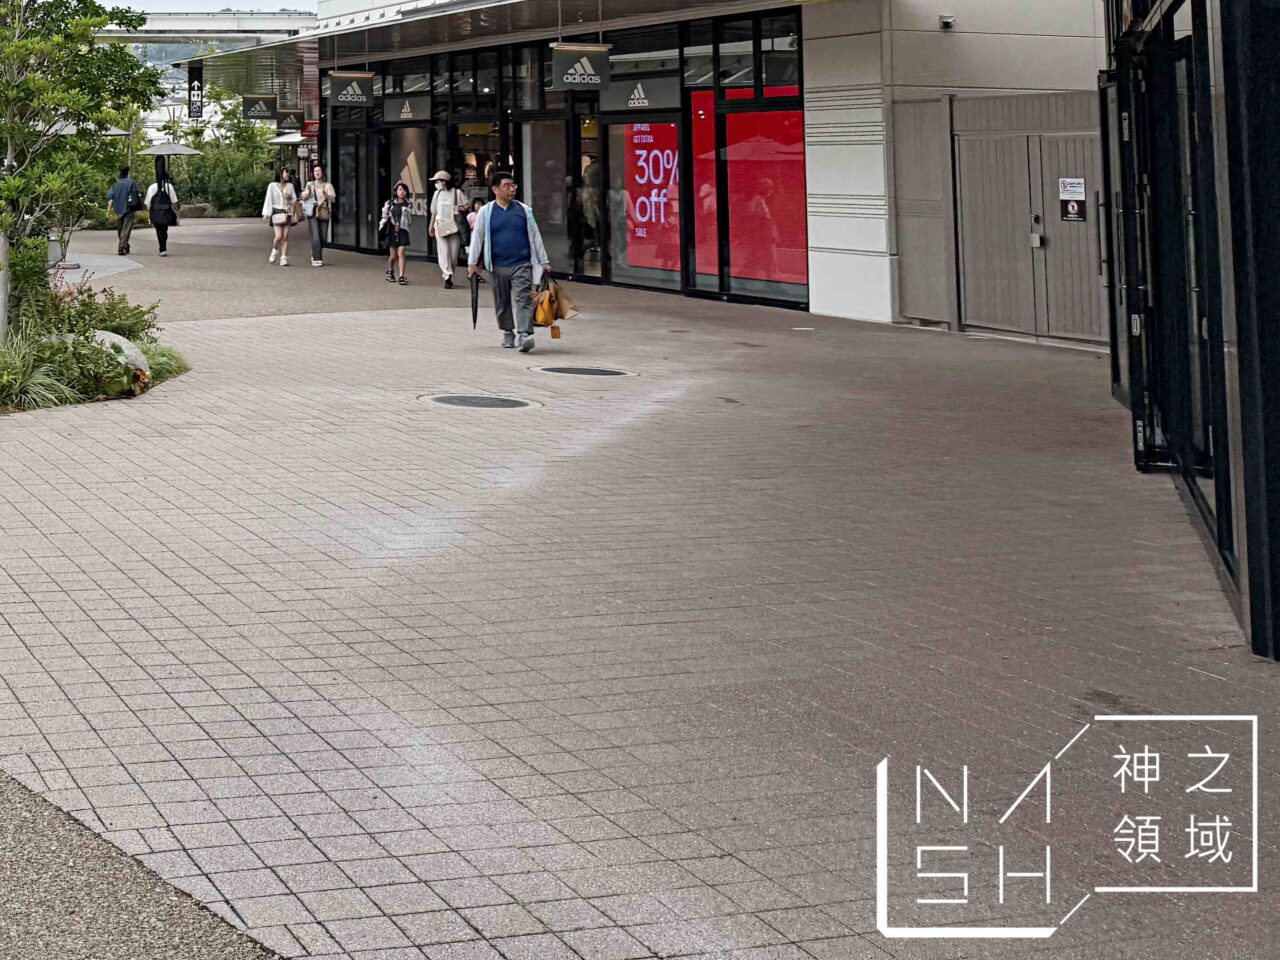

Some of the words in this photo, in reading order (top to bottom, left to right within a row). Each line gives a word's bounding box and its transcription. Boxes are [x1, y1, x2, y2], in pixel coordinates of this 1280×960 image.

[563, 73, 601, 84] adidas
[338, 93, 367, 102] adidas
[628, 98, 649, 107] adidas
[635, 149, 678, 186] 30%
[635, 188, 667, 224] off
